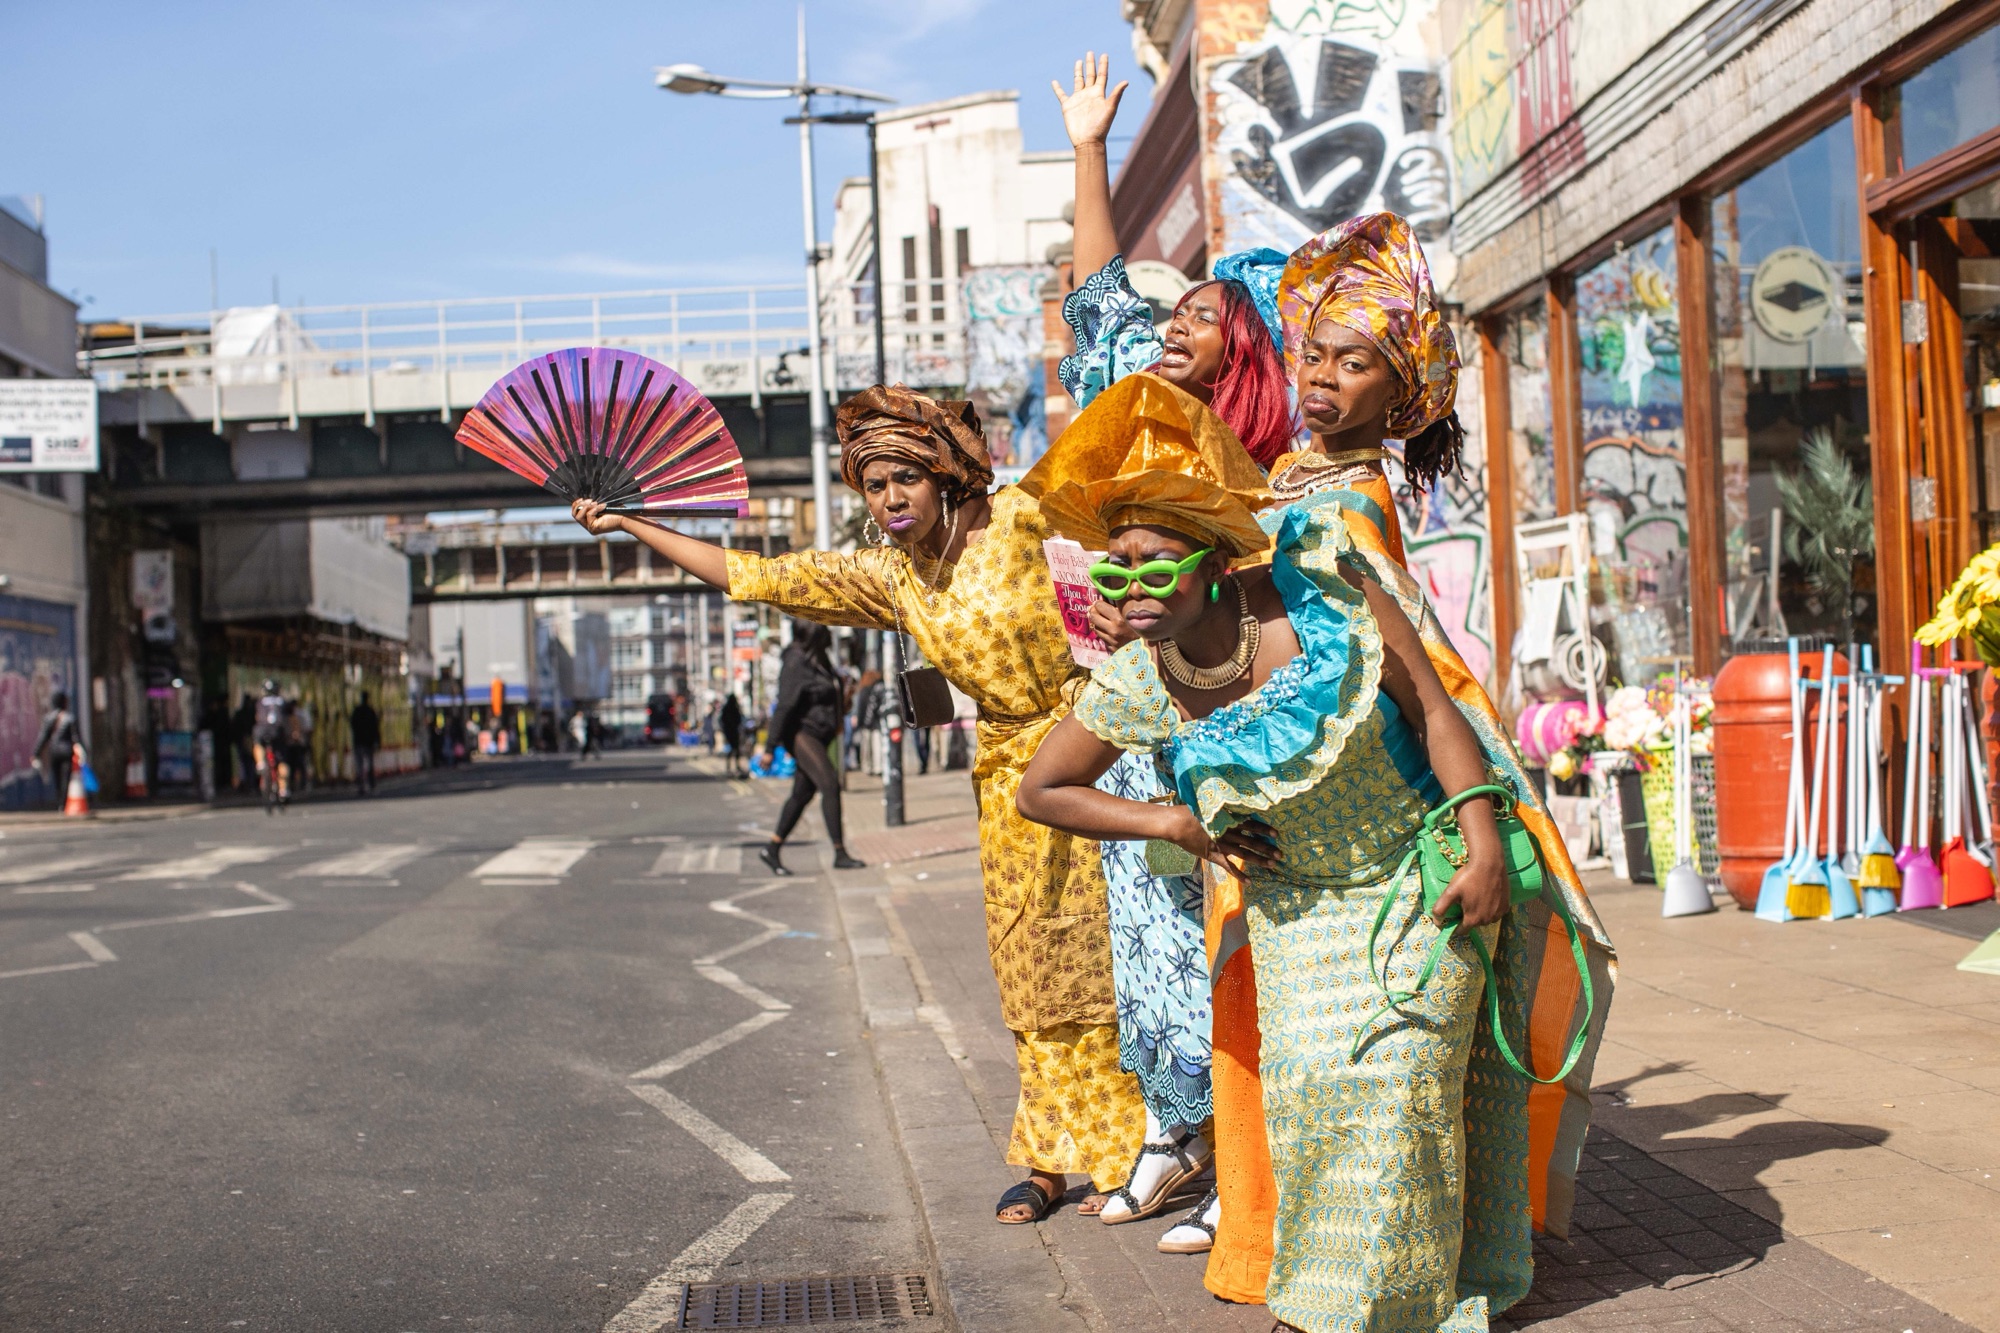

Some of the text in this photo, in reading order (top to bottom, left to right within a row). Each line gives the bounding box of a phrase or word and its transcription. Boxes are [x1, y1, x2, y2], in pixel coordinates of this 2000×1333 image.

[1051, 552, 1070, 569] Holy
[1070, 555, 1089, 569] Bible
[1061, 583, 1082, 600] Thou
